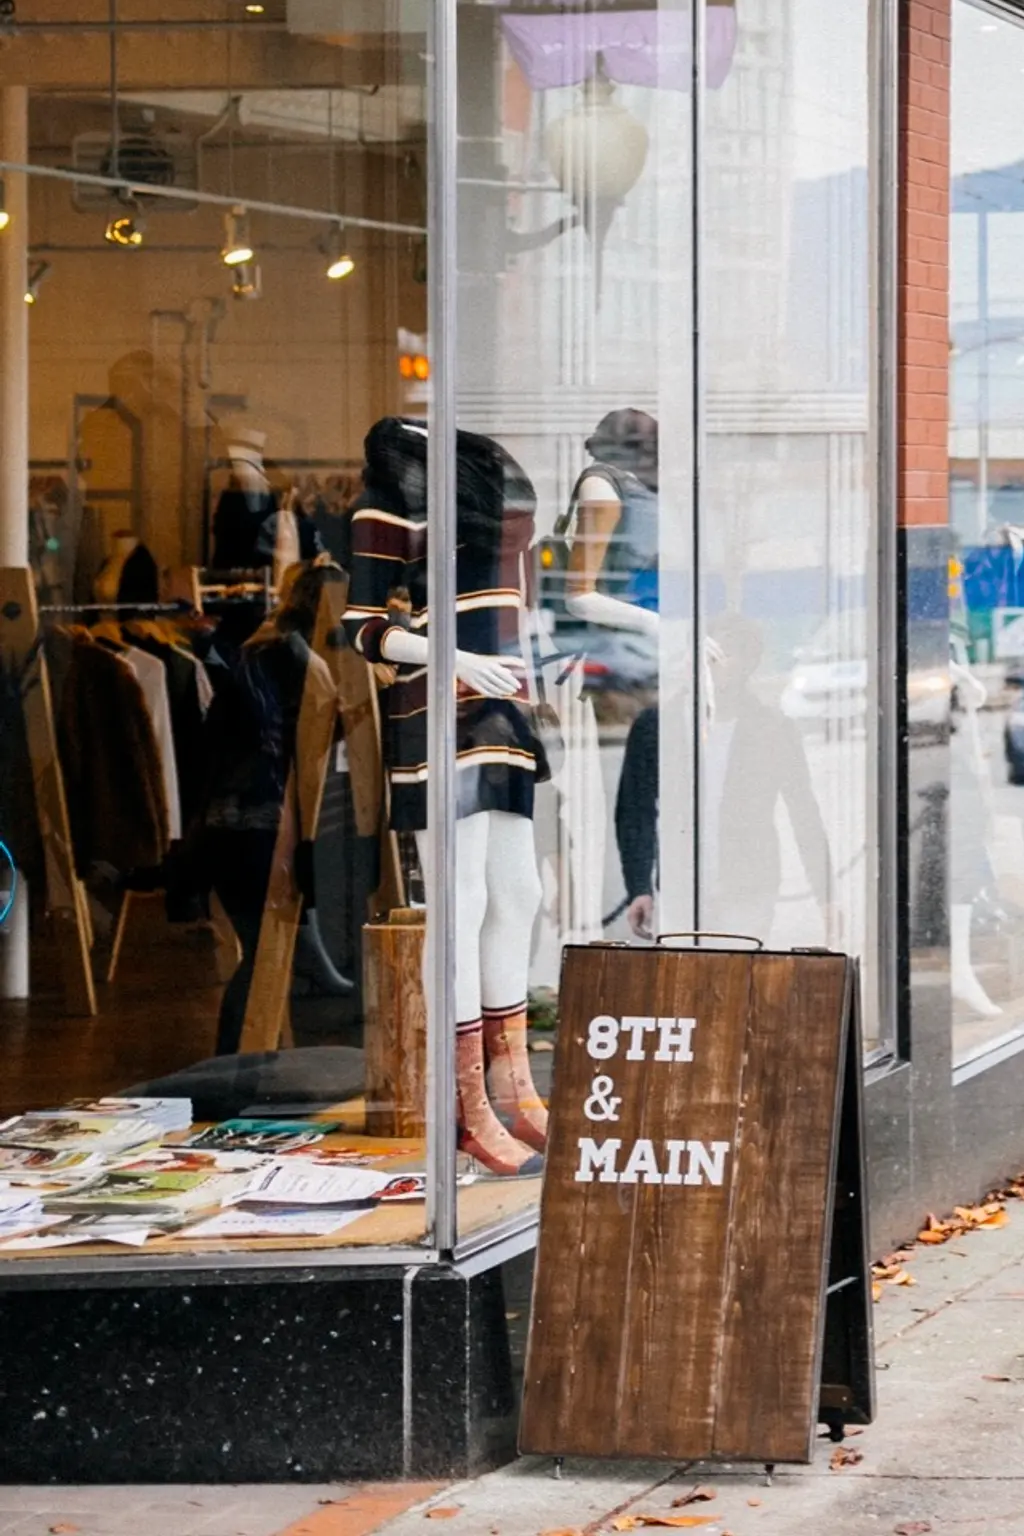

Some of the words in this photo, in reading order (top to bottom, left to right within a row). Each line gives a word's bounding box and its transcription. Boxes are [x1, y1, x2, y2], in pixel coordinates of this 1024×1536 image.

[587, 1015, 697, 1062] 8TH
[584, 1075, 622, 1121] &
[575, 1137, 730, 1186] MAIN
